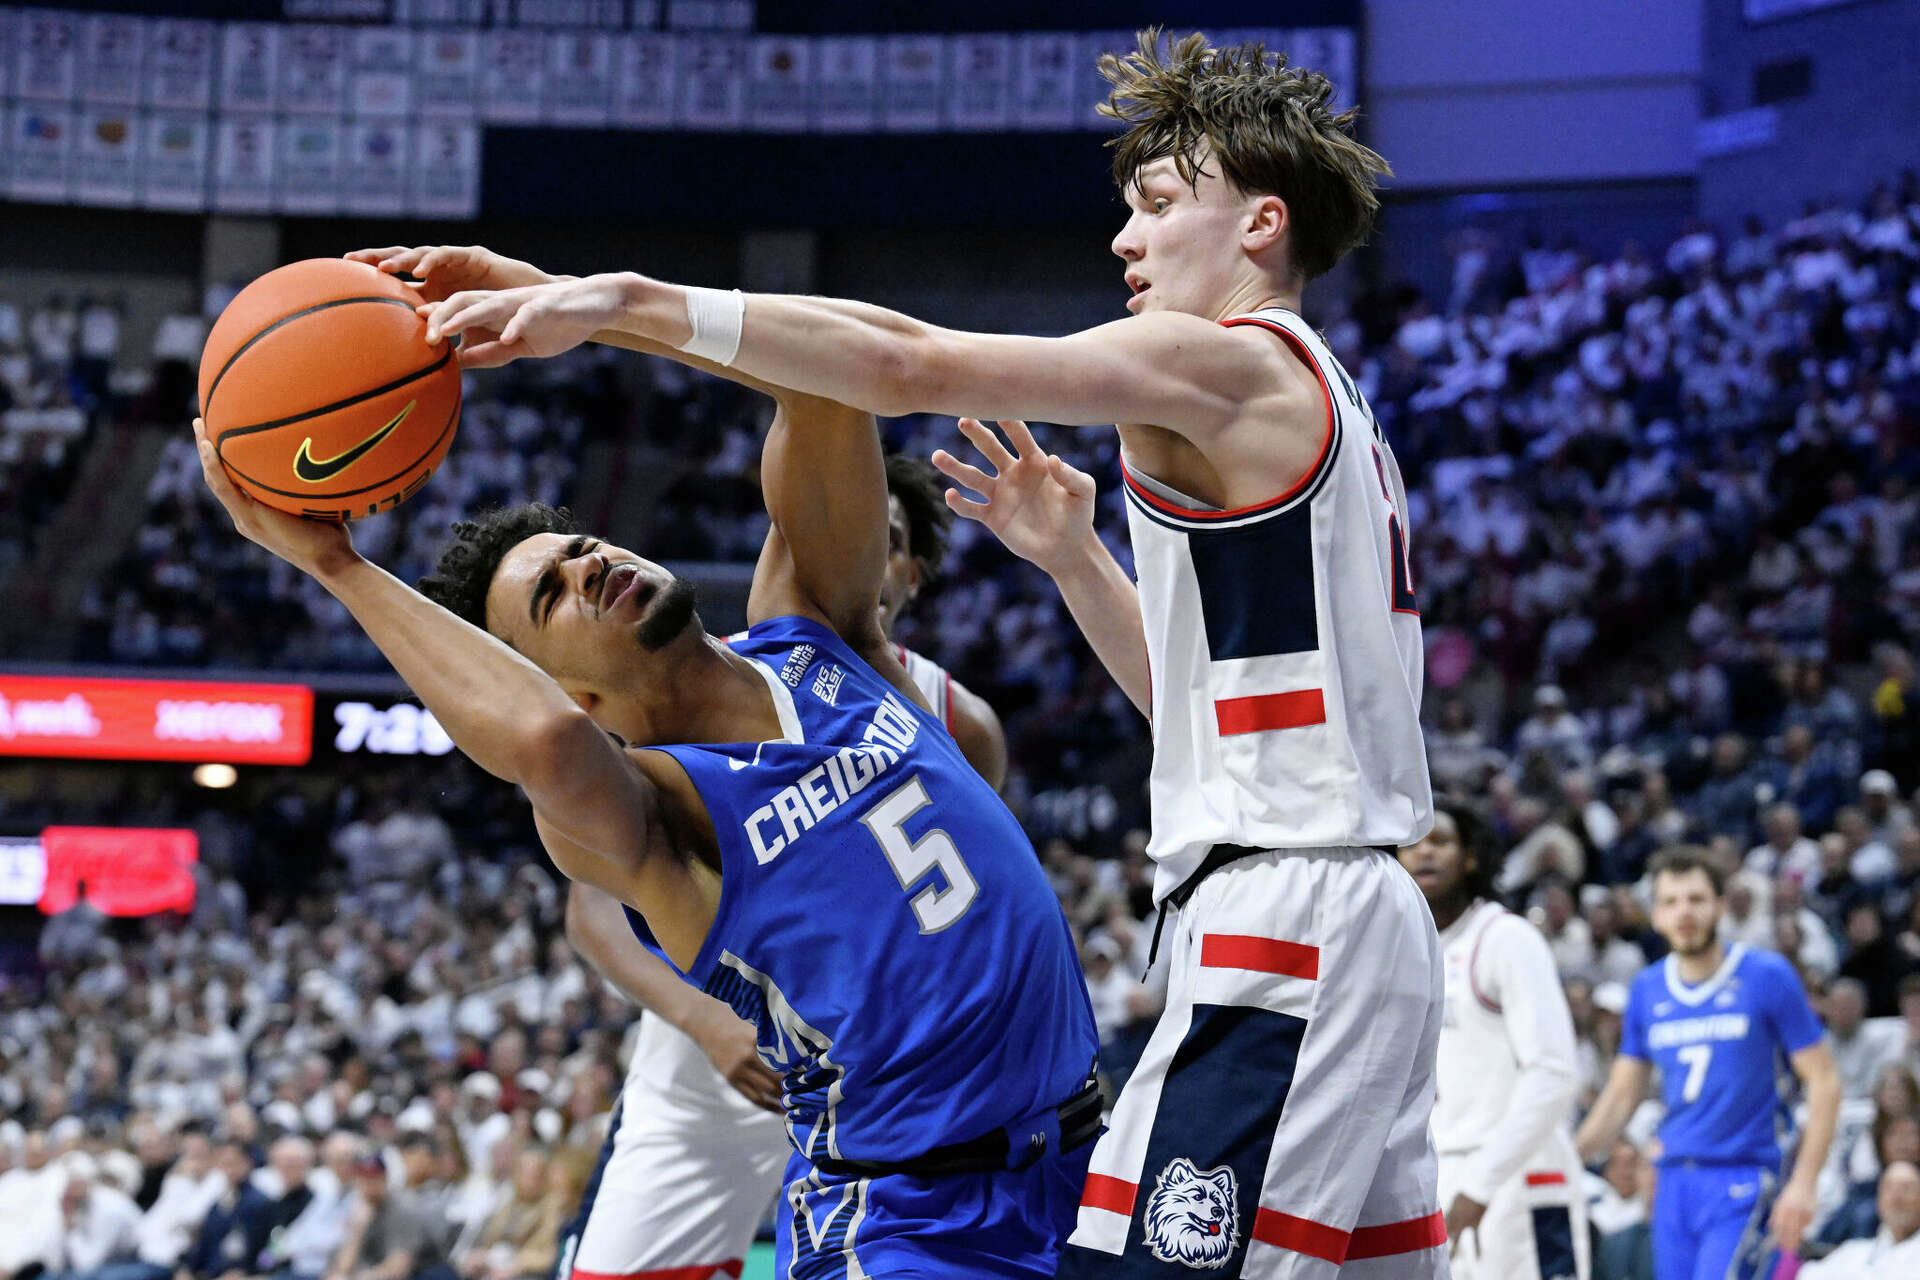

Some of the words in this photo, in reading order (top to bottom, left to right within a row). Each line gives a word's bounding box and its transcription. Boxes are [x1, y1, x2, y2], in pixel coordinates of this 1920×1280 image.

[781, 665, 793, 680] BE
[787, 644, 805, 663] THE
[788, 645, 815, 687] CHANGE
[812, 665, 830, 697] BIG
[821, 664, 842, 703] EAST
[743, 691, 921, 866] CREIGHTON
[859, 775, 979, 935] 5
[1677, 1043, 1713, 1104] 7
